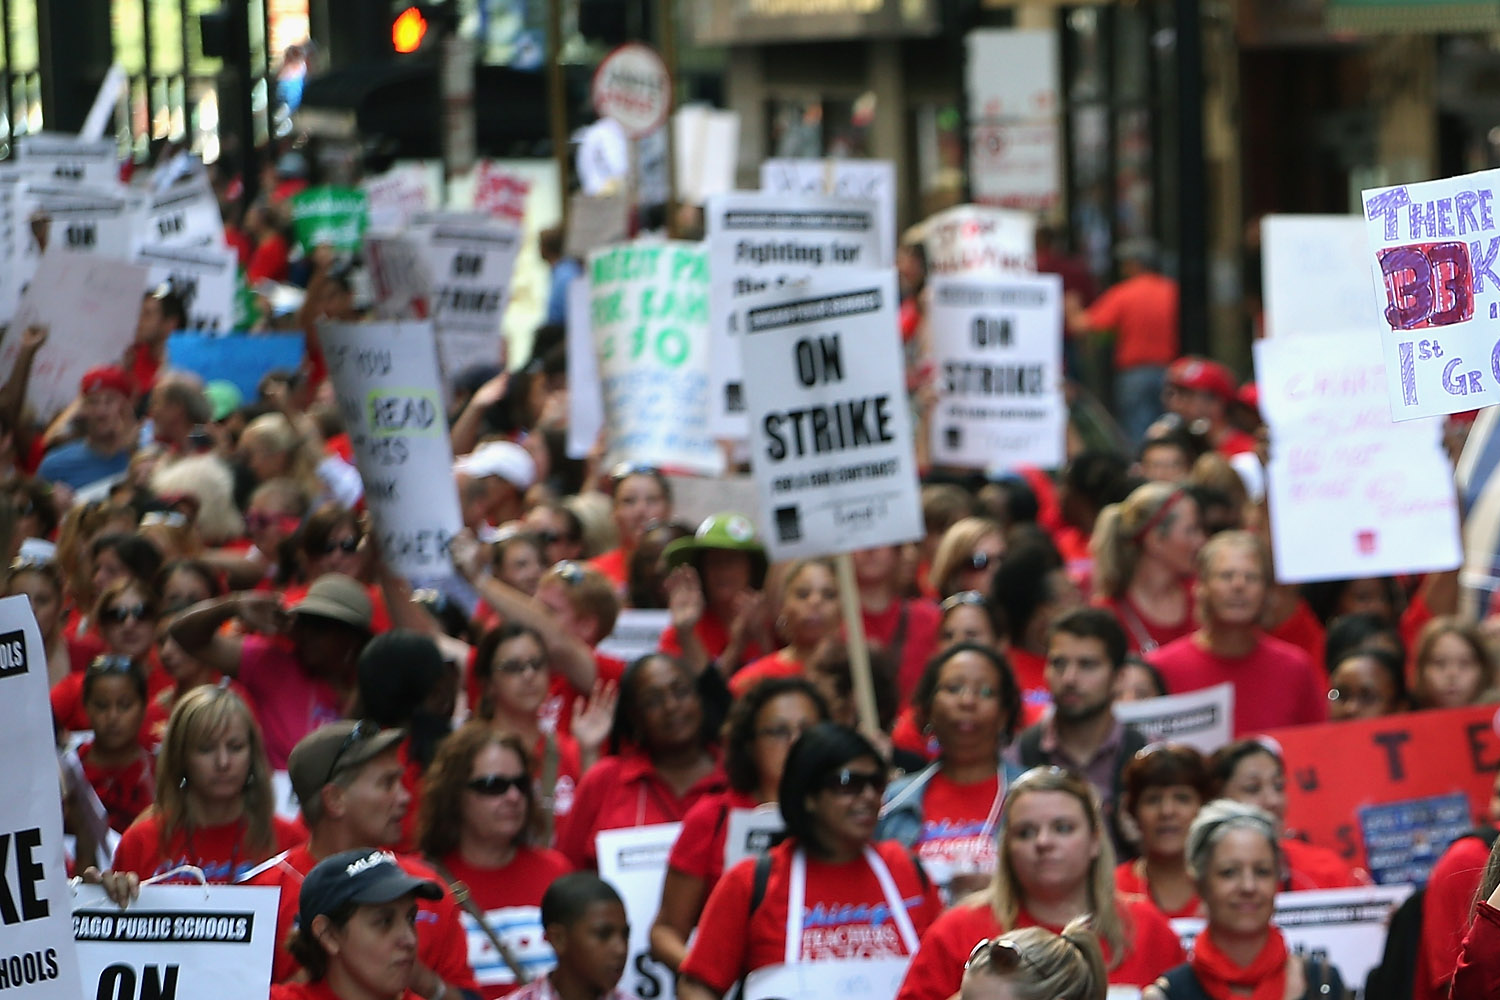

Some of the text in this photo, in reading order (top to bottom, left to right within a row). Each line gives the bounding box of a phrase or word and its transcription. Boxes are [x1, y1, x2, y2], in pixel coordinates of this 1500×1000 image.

[1366, 186, 1495, 241] THERE
[795, 333, 844, 388] ON
[373, 397, 437, 430] READ
[763, 394, 894, 461] STRIKE
[73, 916, 248, 941] CAGO PUBLIC SCHOOLS
[0, 947, 59, 990] HOOLS
